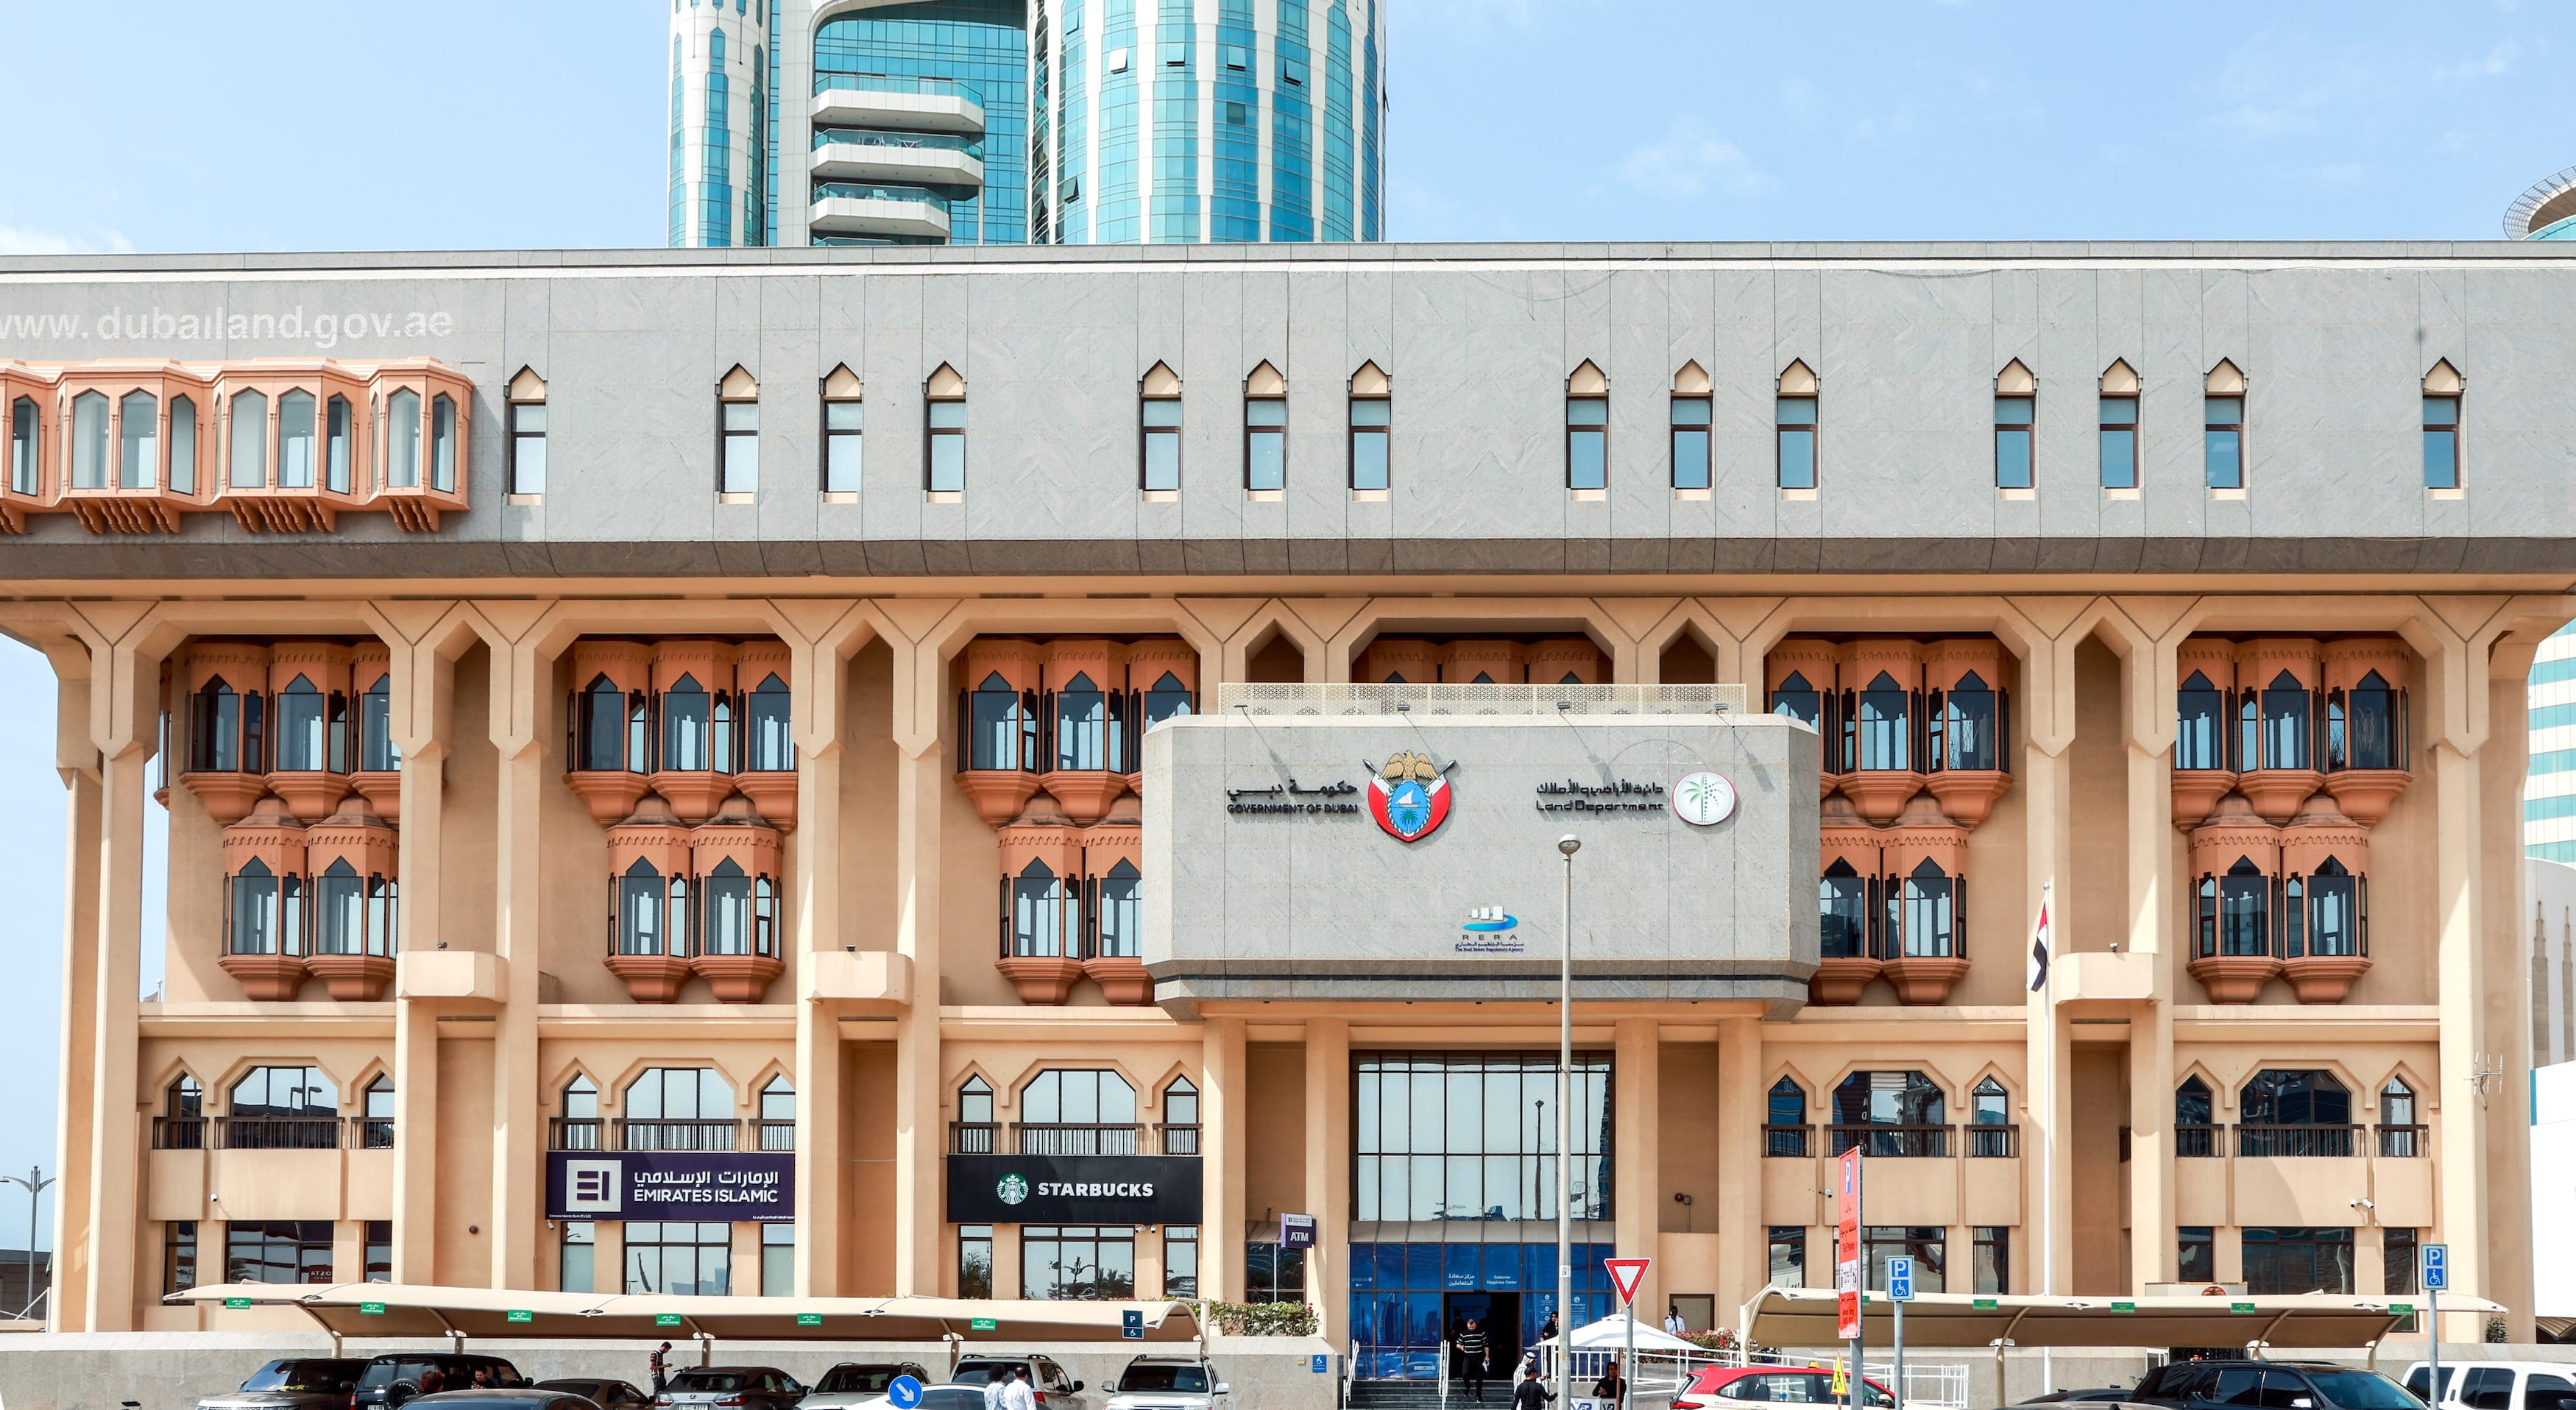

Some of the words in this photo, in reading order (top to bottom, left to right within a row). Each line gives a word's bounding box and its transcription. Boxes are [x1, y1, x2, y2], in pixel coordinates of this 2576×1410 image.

[1227, 784, 1284, 801] دبي
[1227, 804, 1303, 814] GOVERNMENT
[1306, 804, 1322, 814] OF
[1324, 804, 1358, 814] DUBAI
[1536, 800, 1572, 810] Land
[1575, 800, 1663, 815] Department
[634, 1171, 711, 1188] الإسلامي
[718, 1171, 779, 1188] الإمارات
[634, 1188, 712, 1203] EMIRATES
[715, 1189, 779, 1203] ISLAMIC
[1038, 1182, 1154, 1197] STARBUCKS
[1289, 1231, 1309, 1242] ATM
[2429, 1249, 2441, 1265] P
[1894, 1261, 1907, 1277] P
[1130, 1315, 1136, 1323] P
